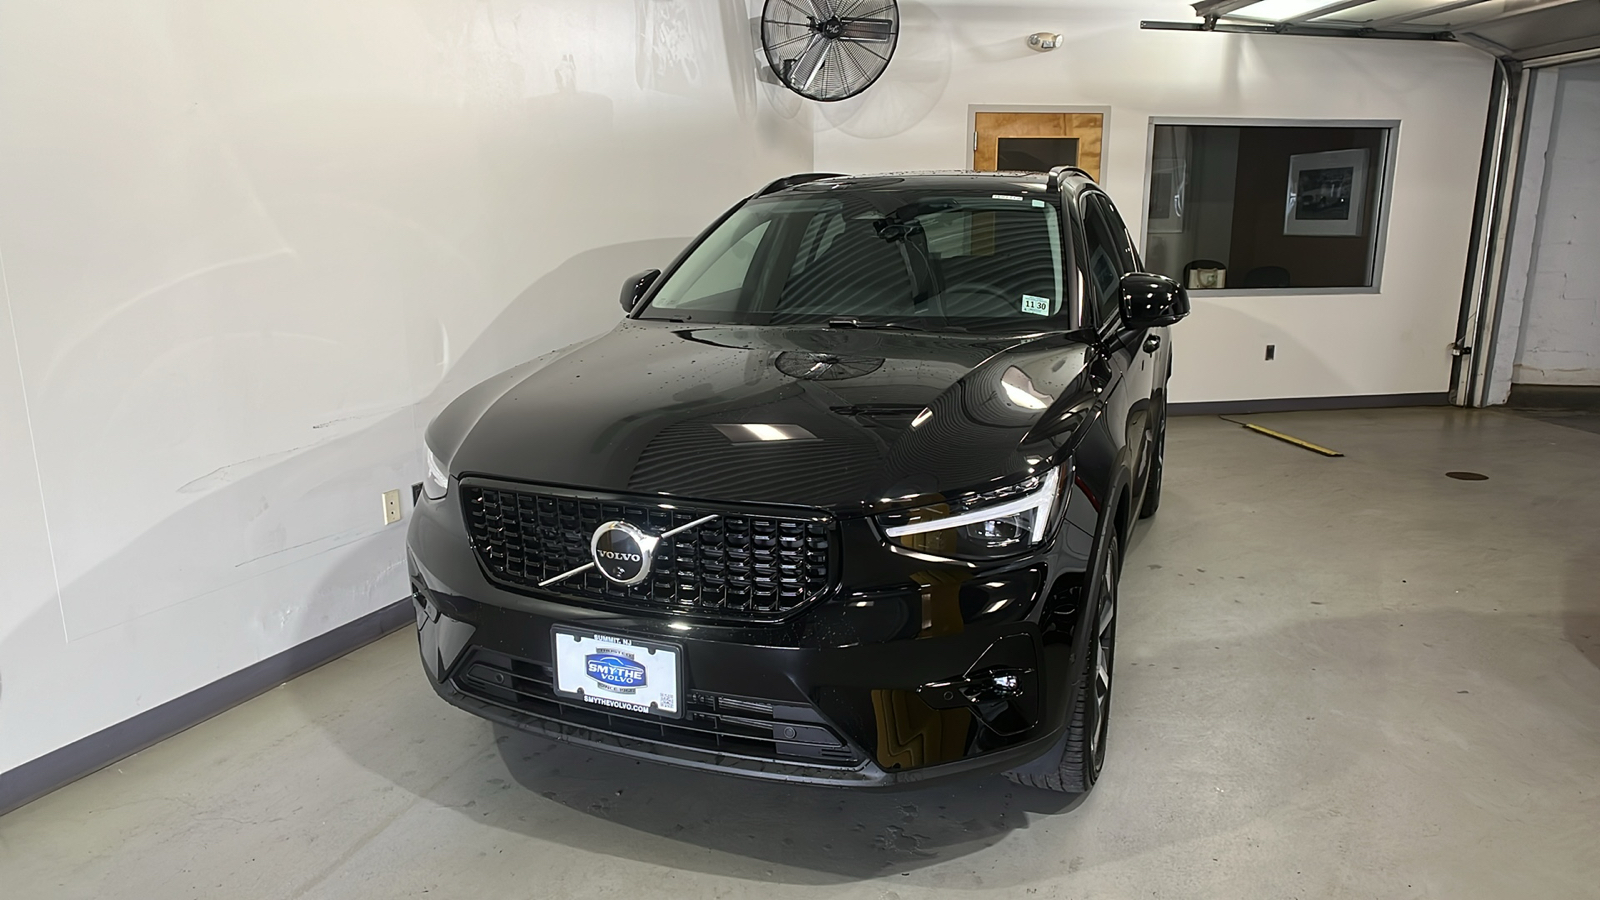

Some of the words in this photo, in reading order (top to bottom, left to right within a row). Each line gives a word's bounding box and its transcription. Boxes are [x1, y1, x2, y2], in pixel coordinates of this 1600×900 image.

[1036, 302, 1046, 310] 30
[597, 549, 641, 562] VOLVO
[588, 664, 642, 680] SMYTHE
[601, 673, 634, 684] VOLVO
[584, 696, 649, 713] SMYTHEVOLVO.COM
